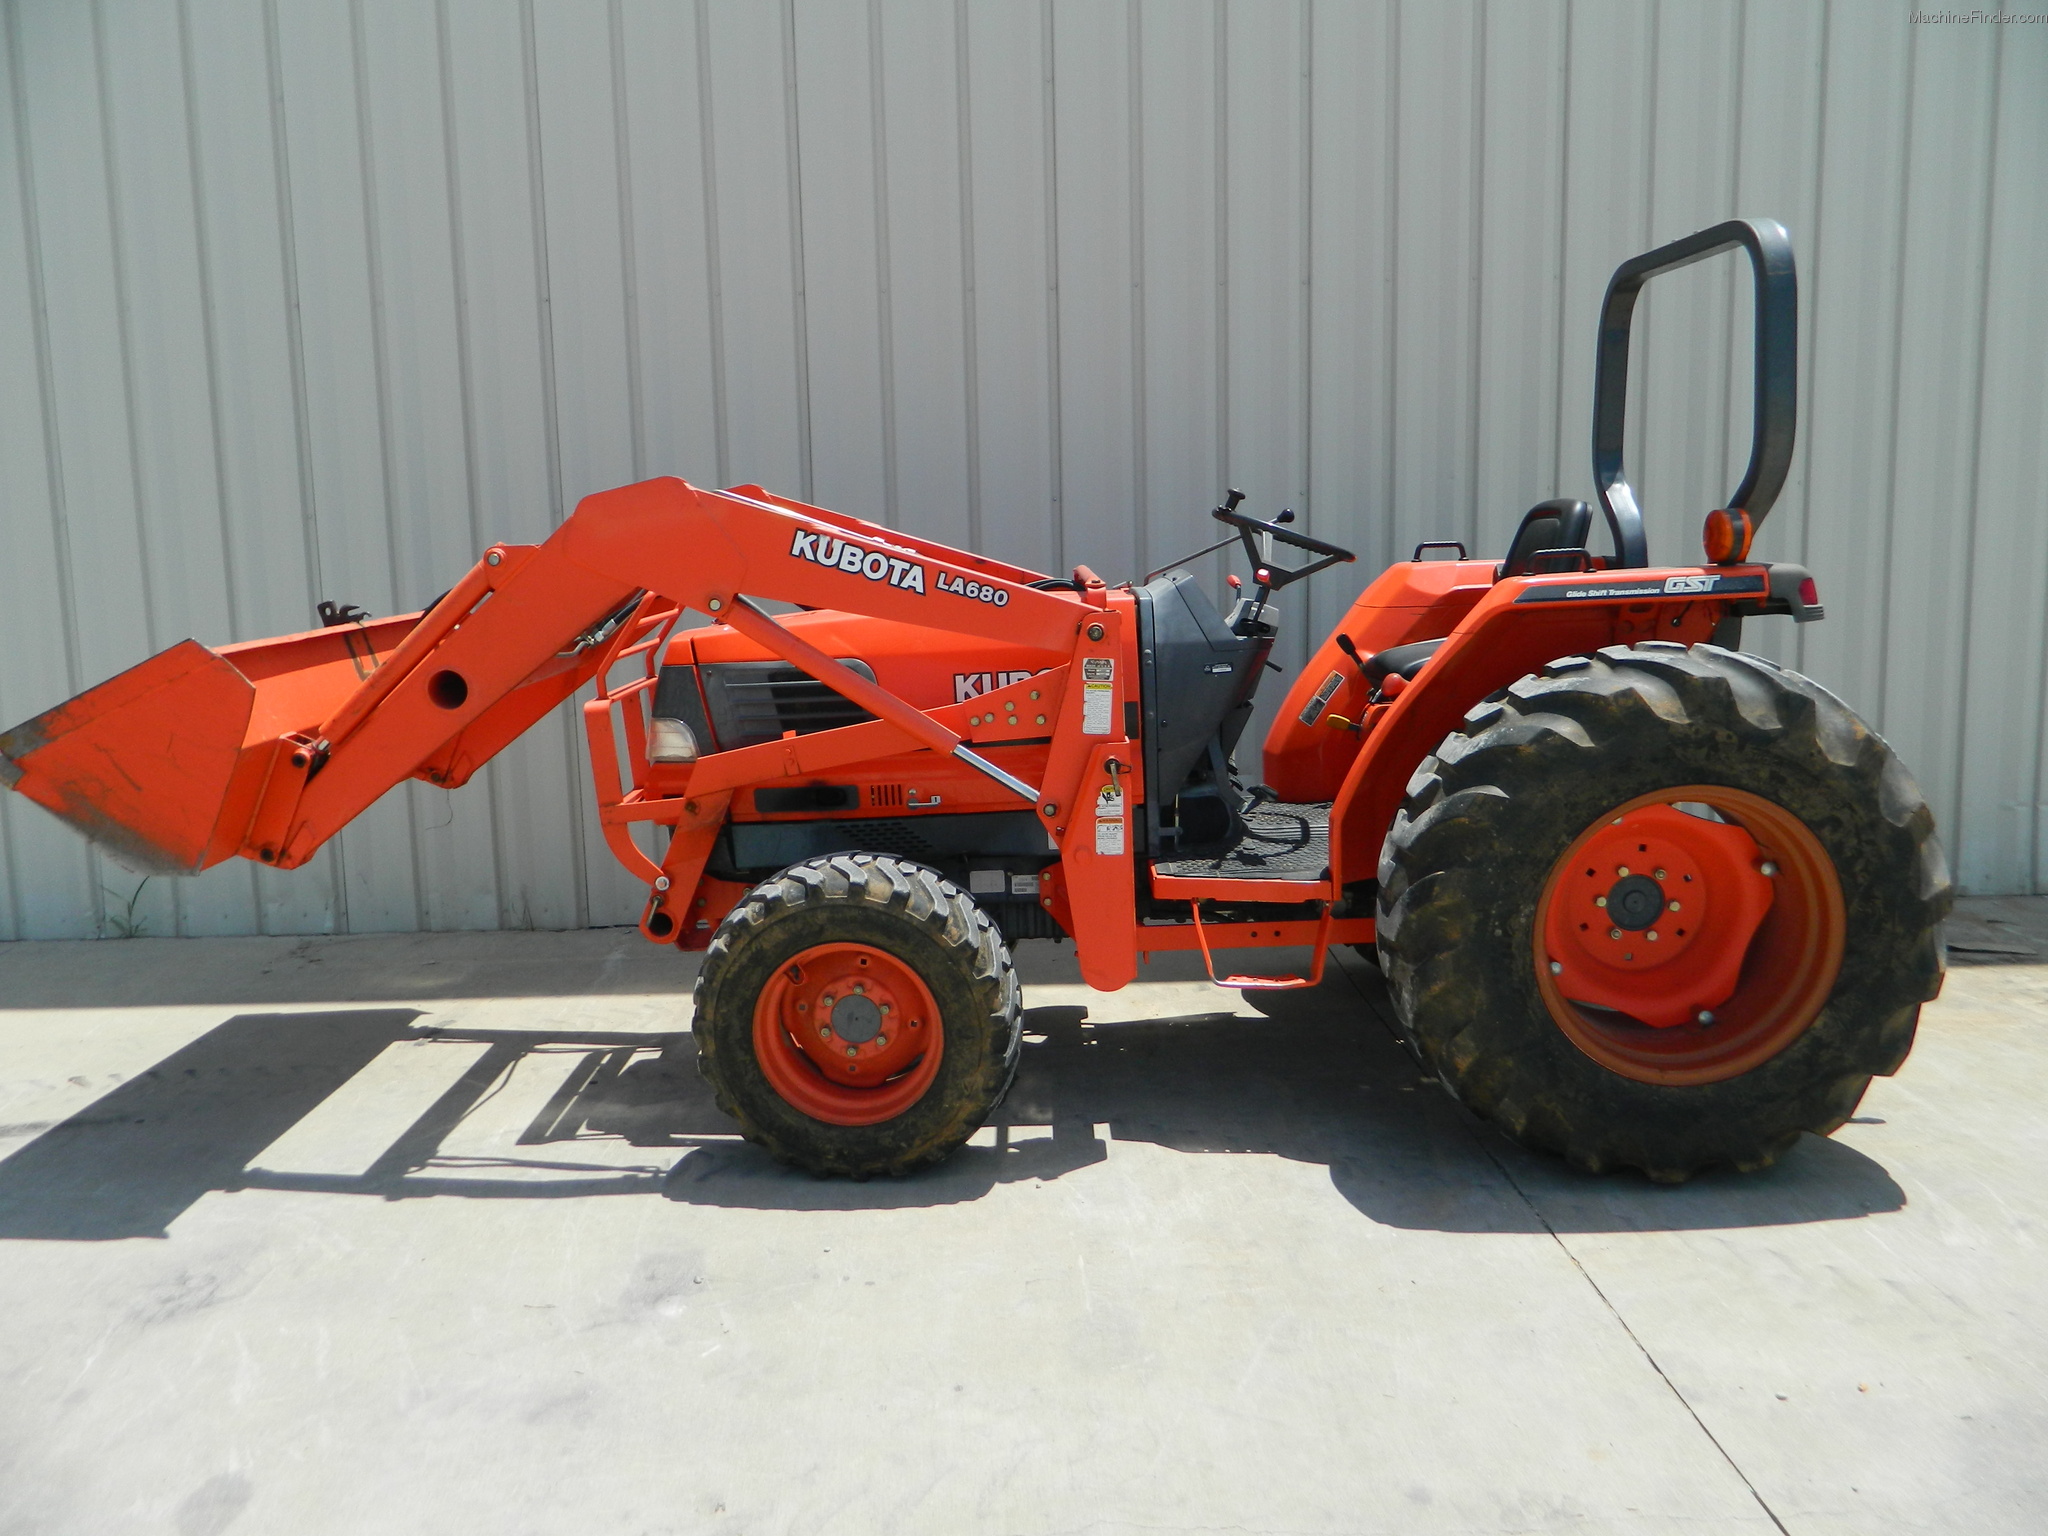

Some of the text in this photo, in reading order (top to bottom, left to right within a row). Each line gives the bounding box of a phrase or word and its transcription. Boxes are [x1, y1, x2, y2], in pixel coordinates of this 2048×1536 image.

[790, 529, 1010, 607] KUBOTA LA680
[1566, 575, 1721, 598] Glide Shift Transmission GST
